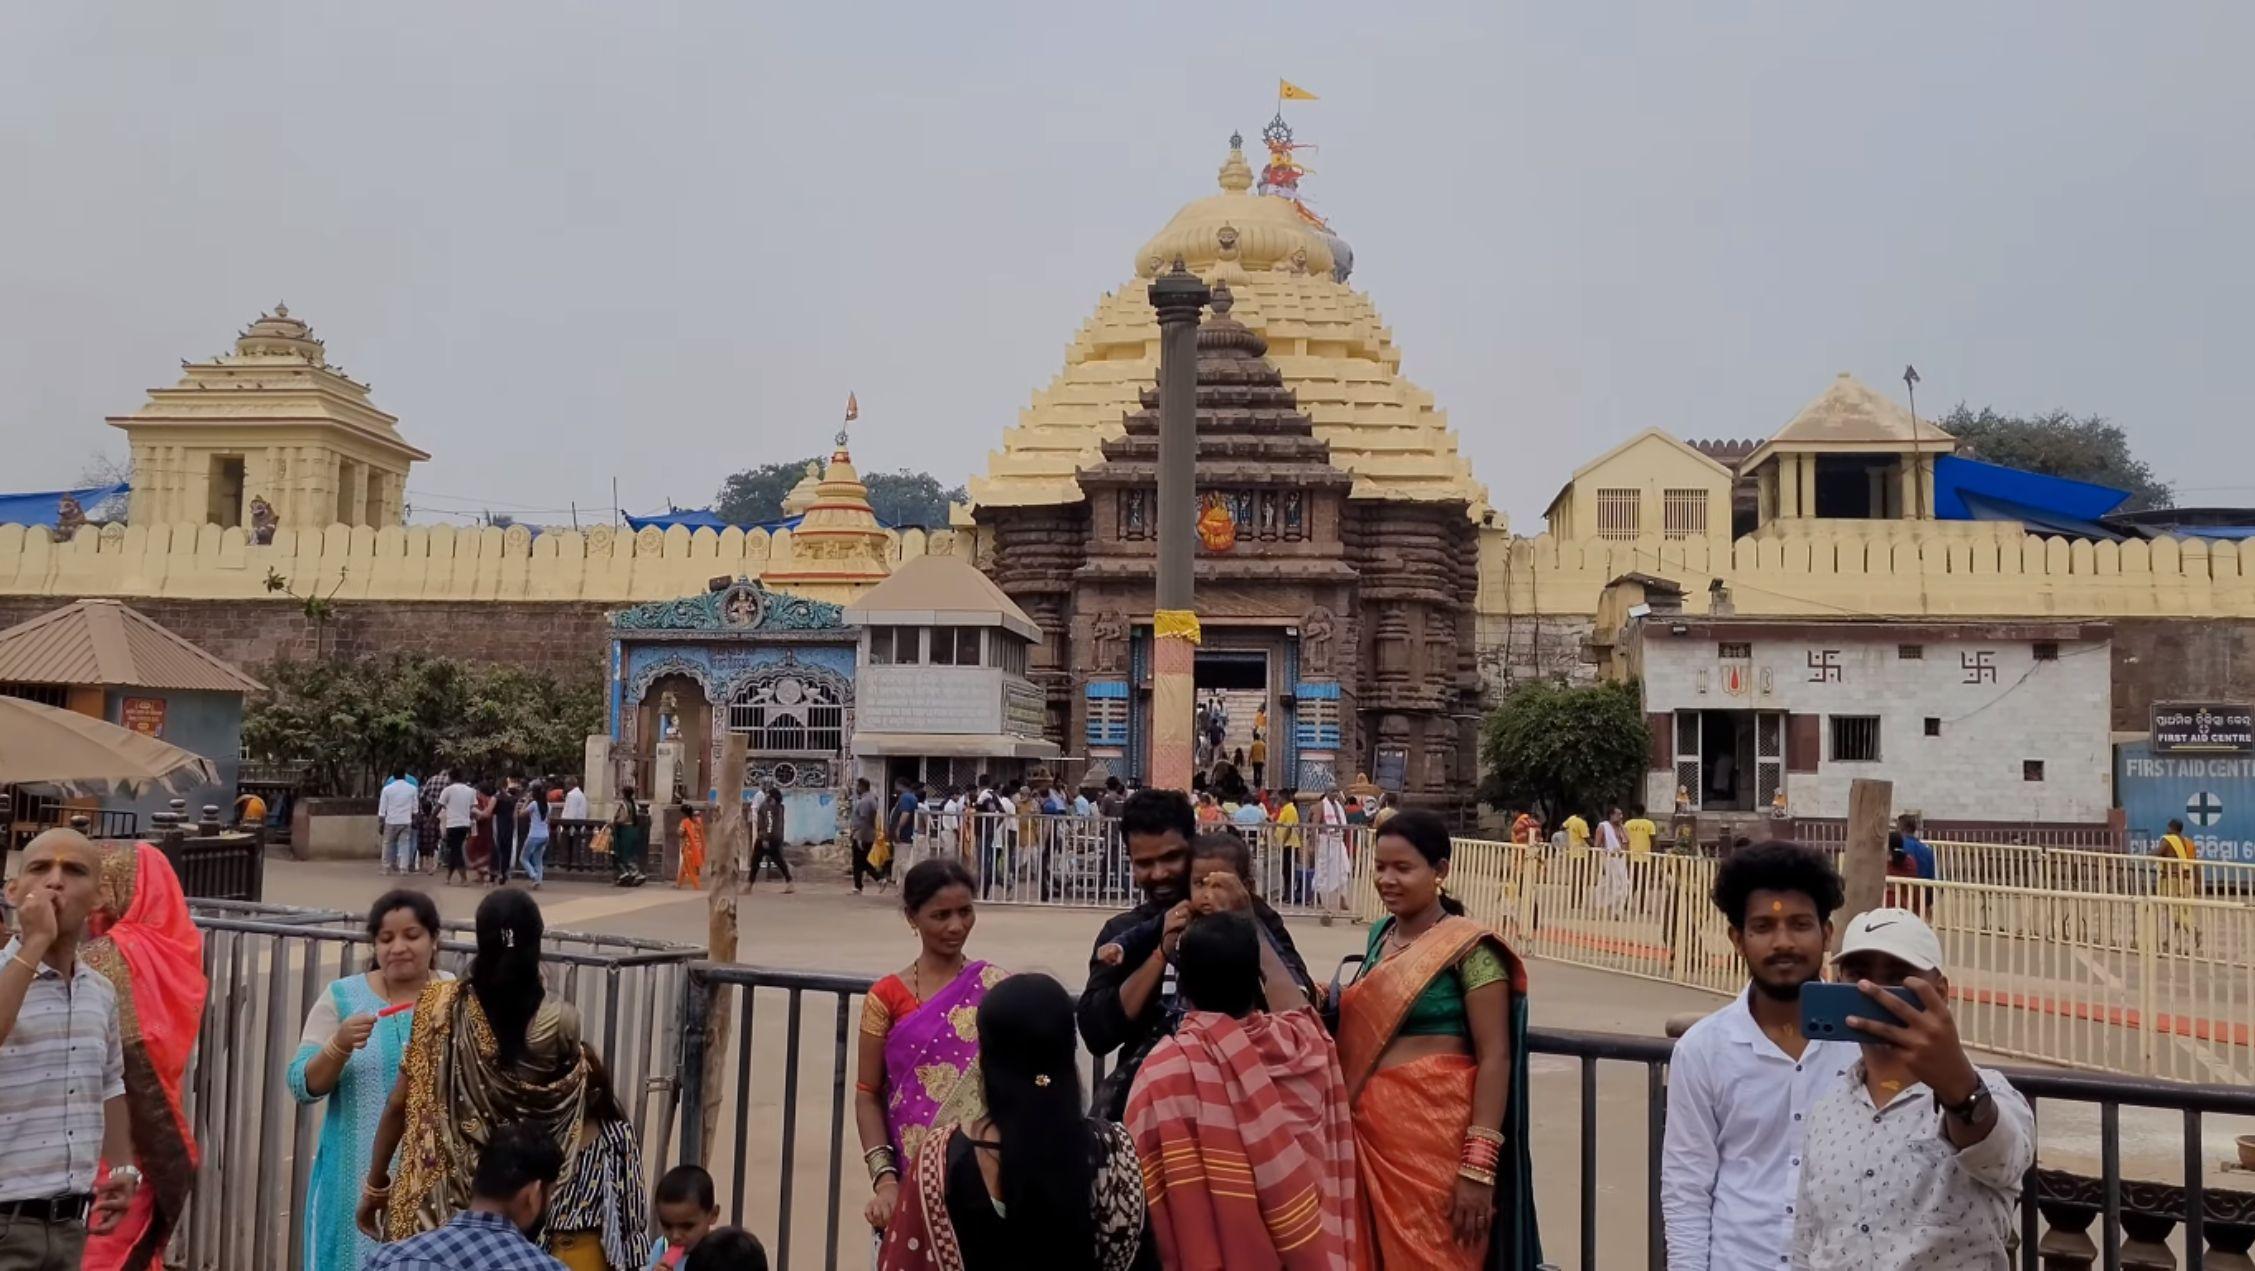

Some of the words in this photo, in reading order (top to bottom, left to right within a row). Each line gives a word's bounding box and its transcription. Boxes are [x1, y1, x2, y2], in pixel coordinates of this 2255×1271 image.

[2157, 734, 2187, 742] FIRST
[2190, 734, 2208, 742] AID
[2211, 734, 2252, 742] CENTRE
[2126, 759, 2175, 777] FIRST
[2178, 759, 2206, 777] AID
[2208, 759, 2255, 777] CENT
